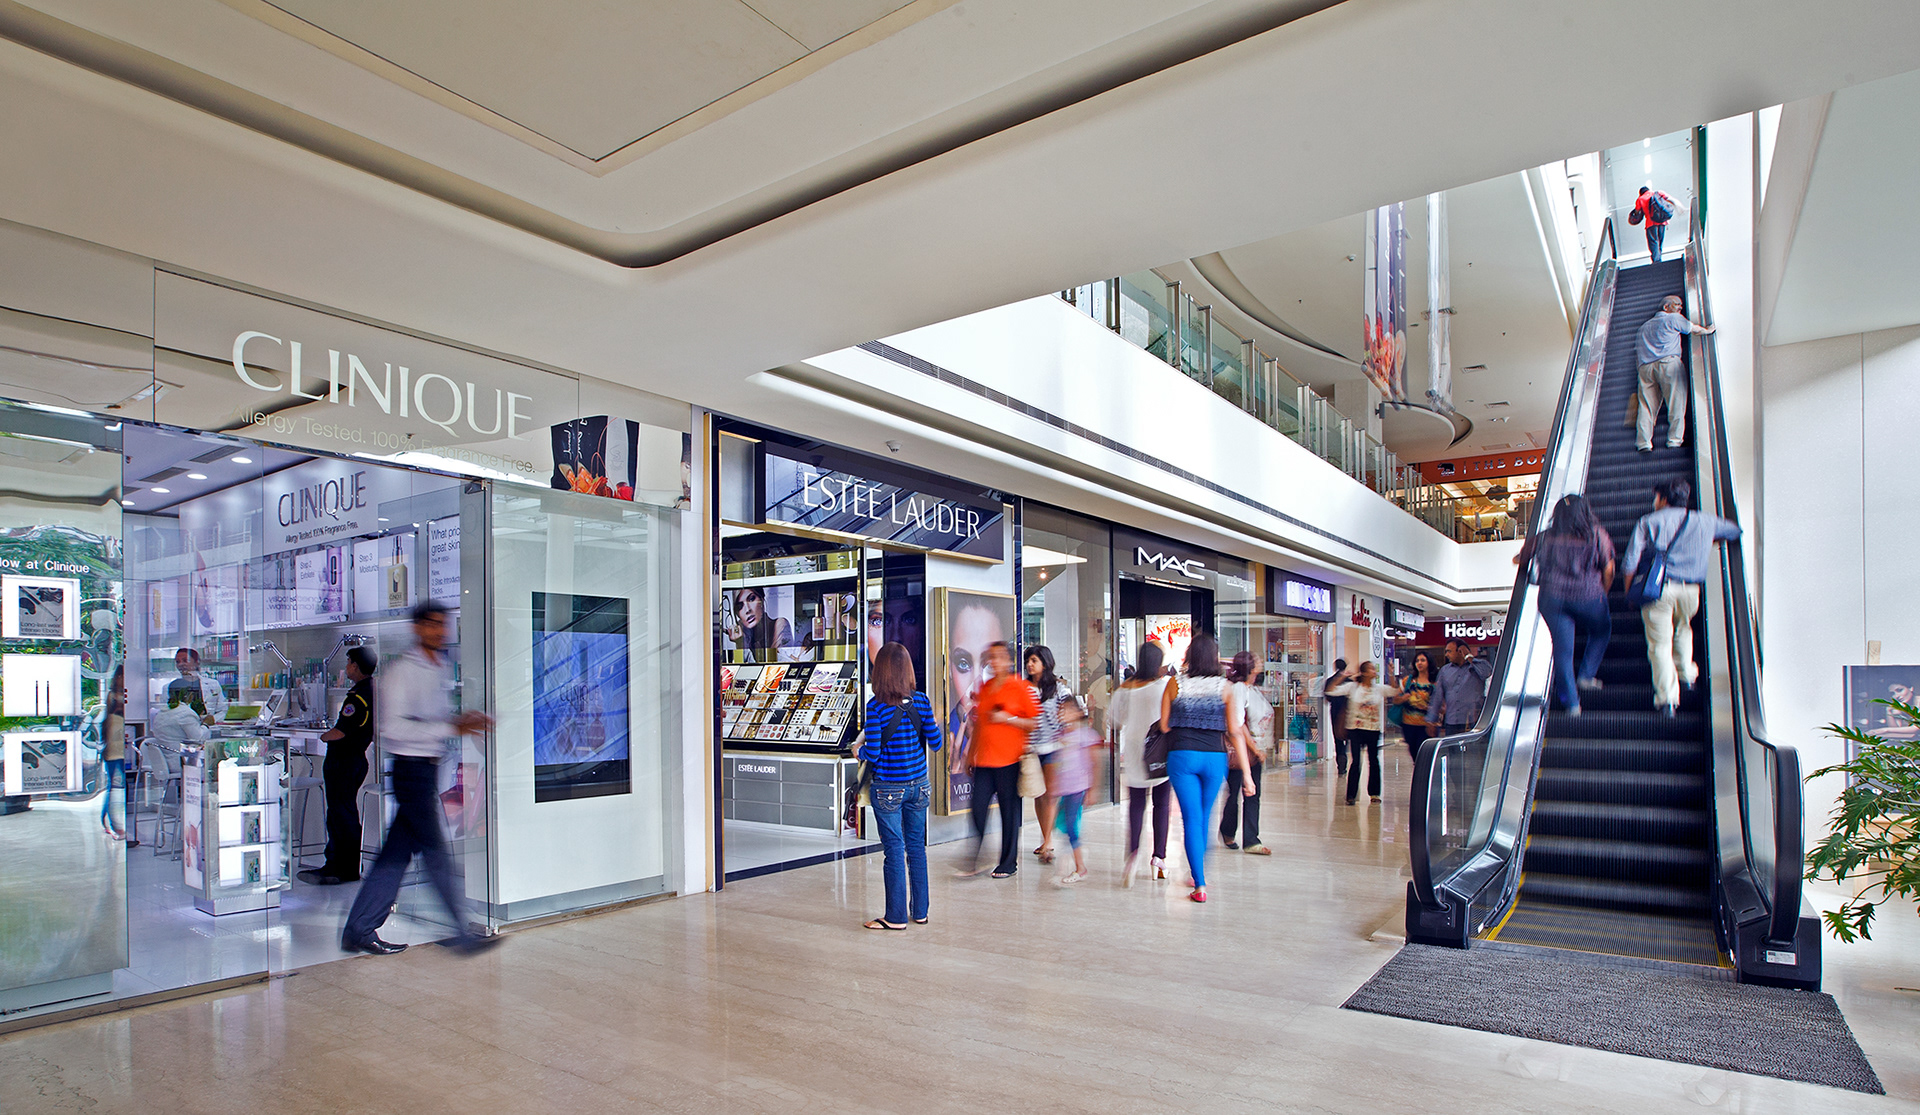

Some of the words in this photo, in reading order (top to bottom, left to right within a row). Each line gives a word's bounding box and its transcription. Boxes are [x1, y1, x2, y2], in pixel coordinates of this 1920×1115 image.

[232, 330, 533, 442] CLINIQUE
[230, 406, 297, 434] Allergy
[301, 416, 366, 444] Tested.
[370, 430, 416, 452] 100%
[421, 439, 500, 470] Fragrance
[502, 454, 536, 474] Free.
[1473, 457, 1506, 471] THE
[277, 471, 367, 527] CLINIQUE
[891, 492, 981, 540] LAUDER
[430, 528, 447, 540] What
[430, 542, 447, 557] great
[26, 560, 39, 570] at
[45, 560, 90, 574] Clinique
[238, 745, 259, 753] New
[754, 765, 776, 774] LAUDER
